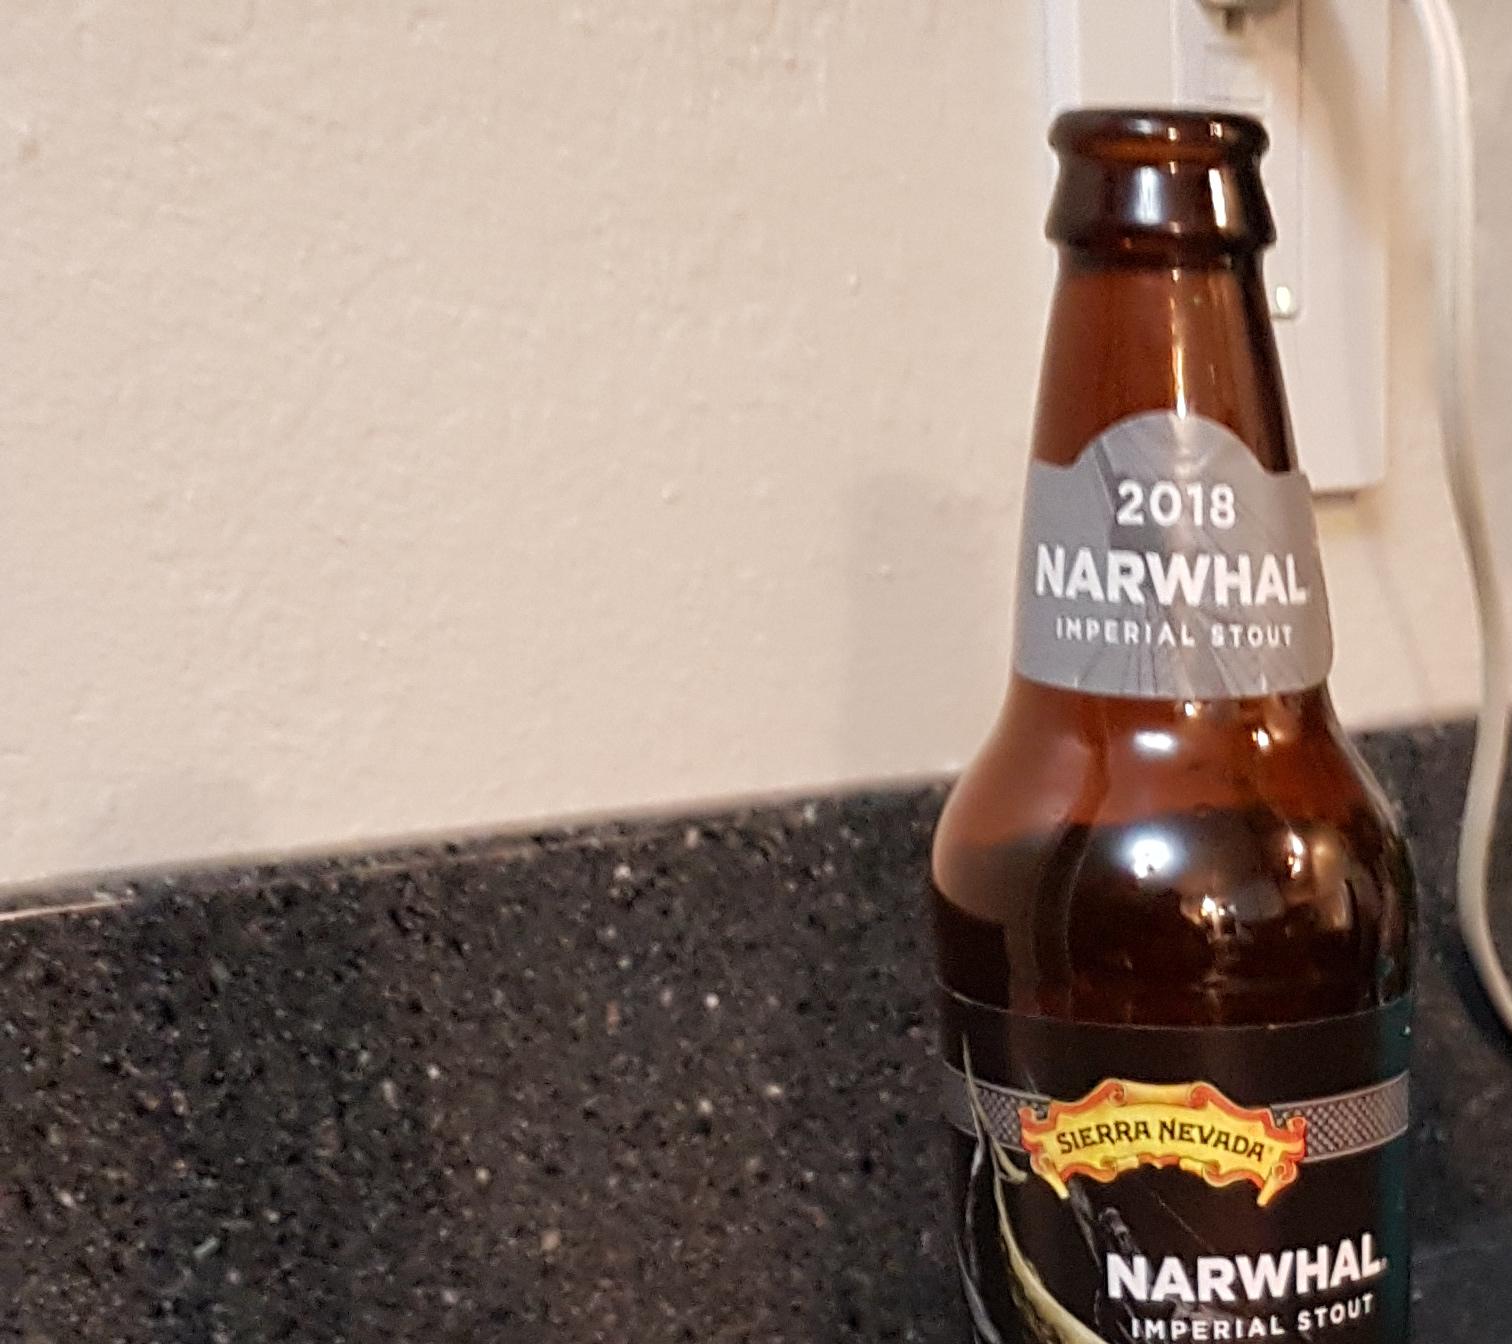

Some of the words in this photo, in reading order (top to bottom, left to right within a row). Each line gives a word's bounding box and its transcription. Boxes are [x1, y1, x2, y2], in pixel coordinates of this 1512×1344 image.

[1115, 481, 1238, 530] 2018
[1035, 543, 1310, 607] NARWHAL
[1055, 615, 1196, 647] IMPERIAL
[1211, 623, 1293, 649] STOUT
[1056, 1119, 1153, 1155] SIERRA
[1158, 1117, 1267, 1163] NEVADA
[1106, 1231, 1382, 1304] NARWHAL
[1131, 1316, 1286, 1342] IMPERIAL
[1297, 1292, 1375, 1333] STOUT
